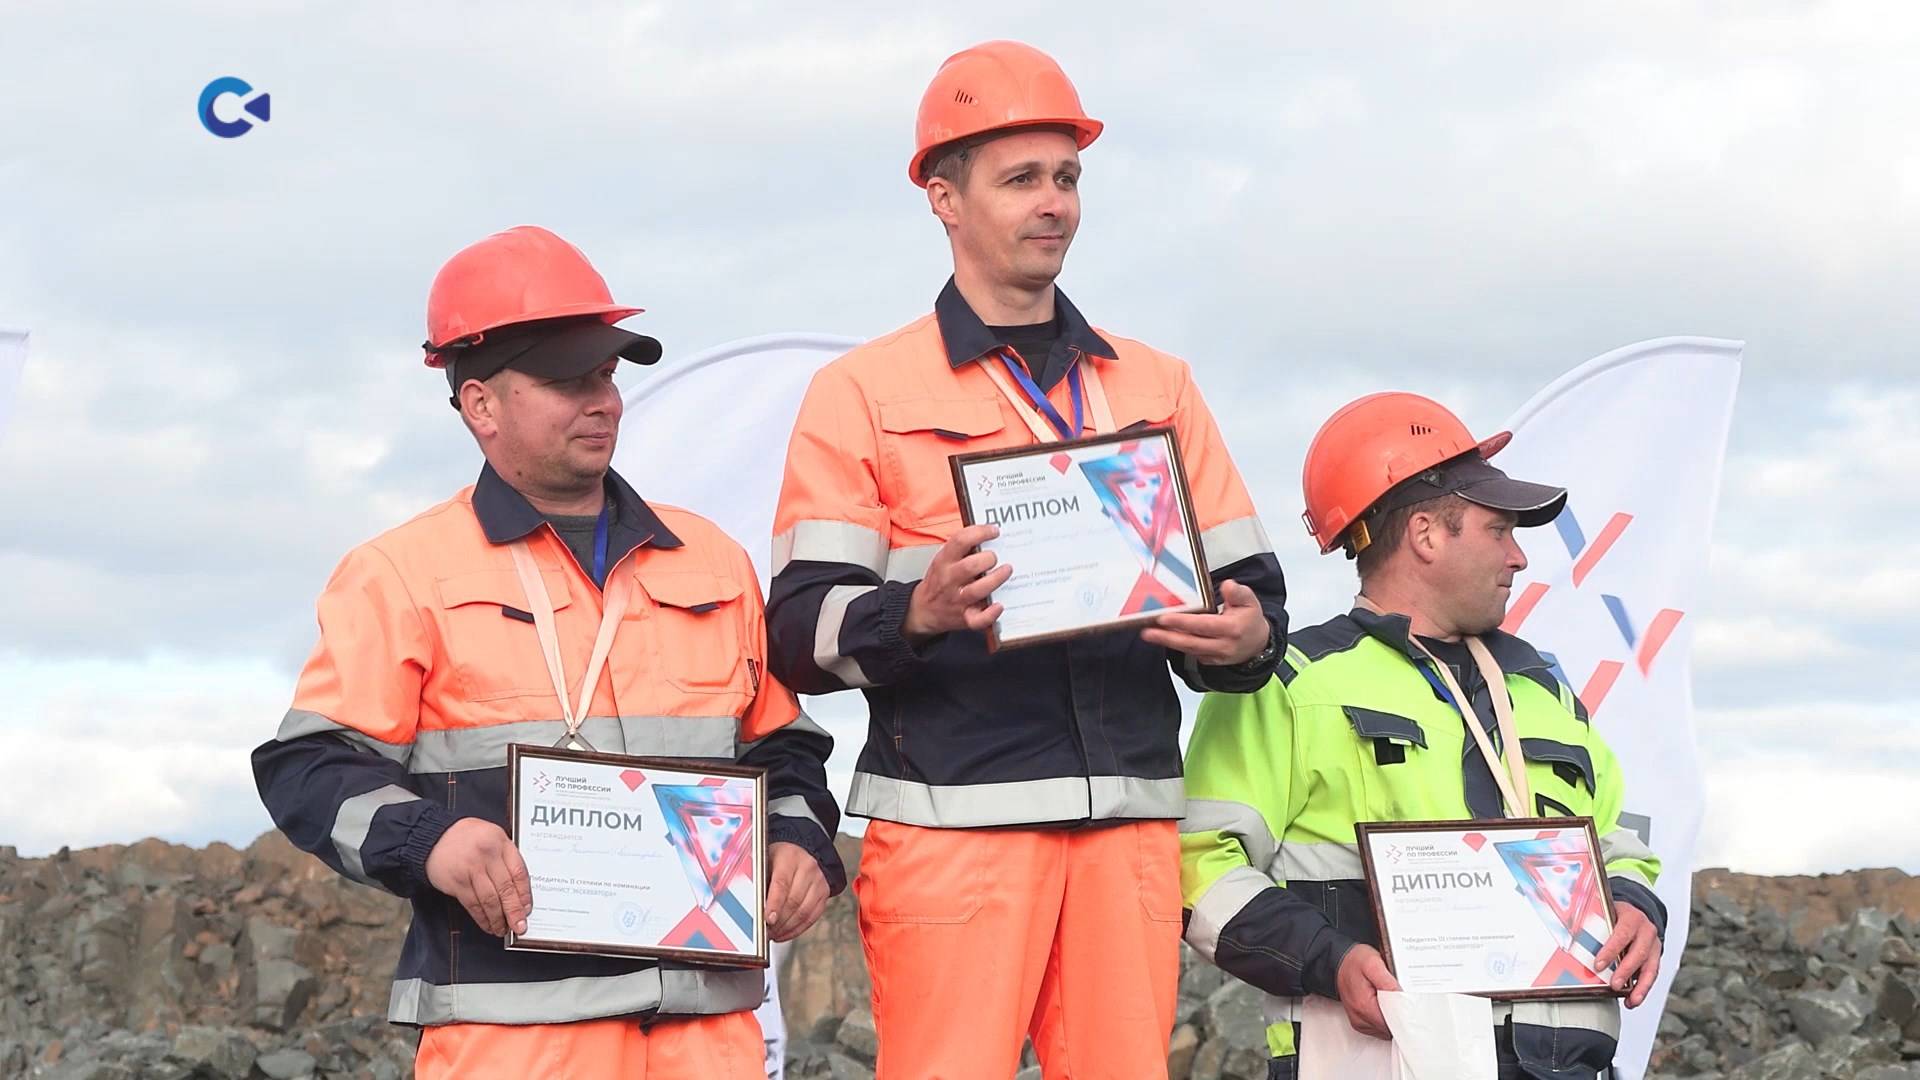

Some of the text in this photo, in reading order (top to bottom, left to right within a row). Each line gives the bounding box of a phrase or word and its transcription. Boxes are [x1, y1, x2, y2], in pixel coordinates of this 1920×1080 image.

[985, 495, 1080, 528] ДИПЛОМ
[555, 775, 588, 784] ЛУЧШИЙ
[555, 782, 567, 790] ПО
[567, 783, 612, 793] ПРОФЕССИИ
[530, 804, 643, 832] ДИПЛОМ
[1417, 850, 1458, 858] ПРОФЕССИИ
[1392, 871, 1493, 894] ДИПЛОМ
